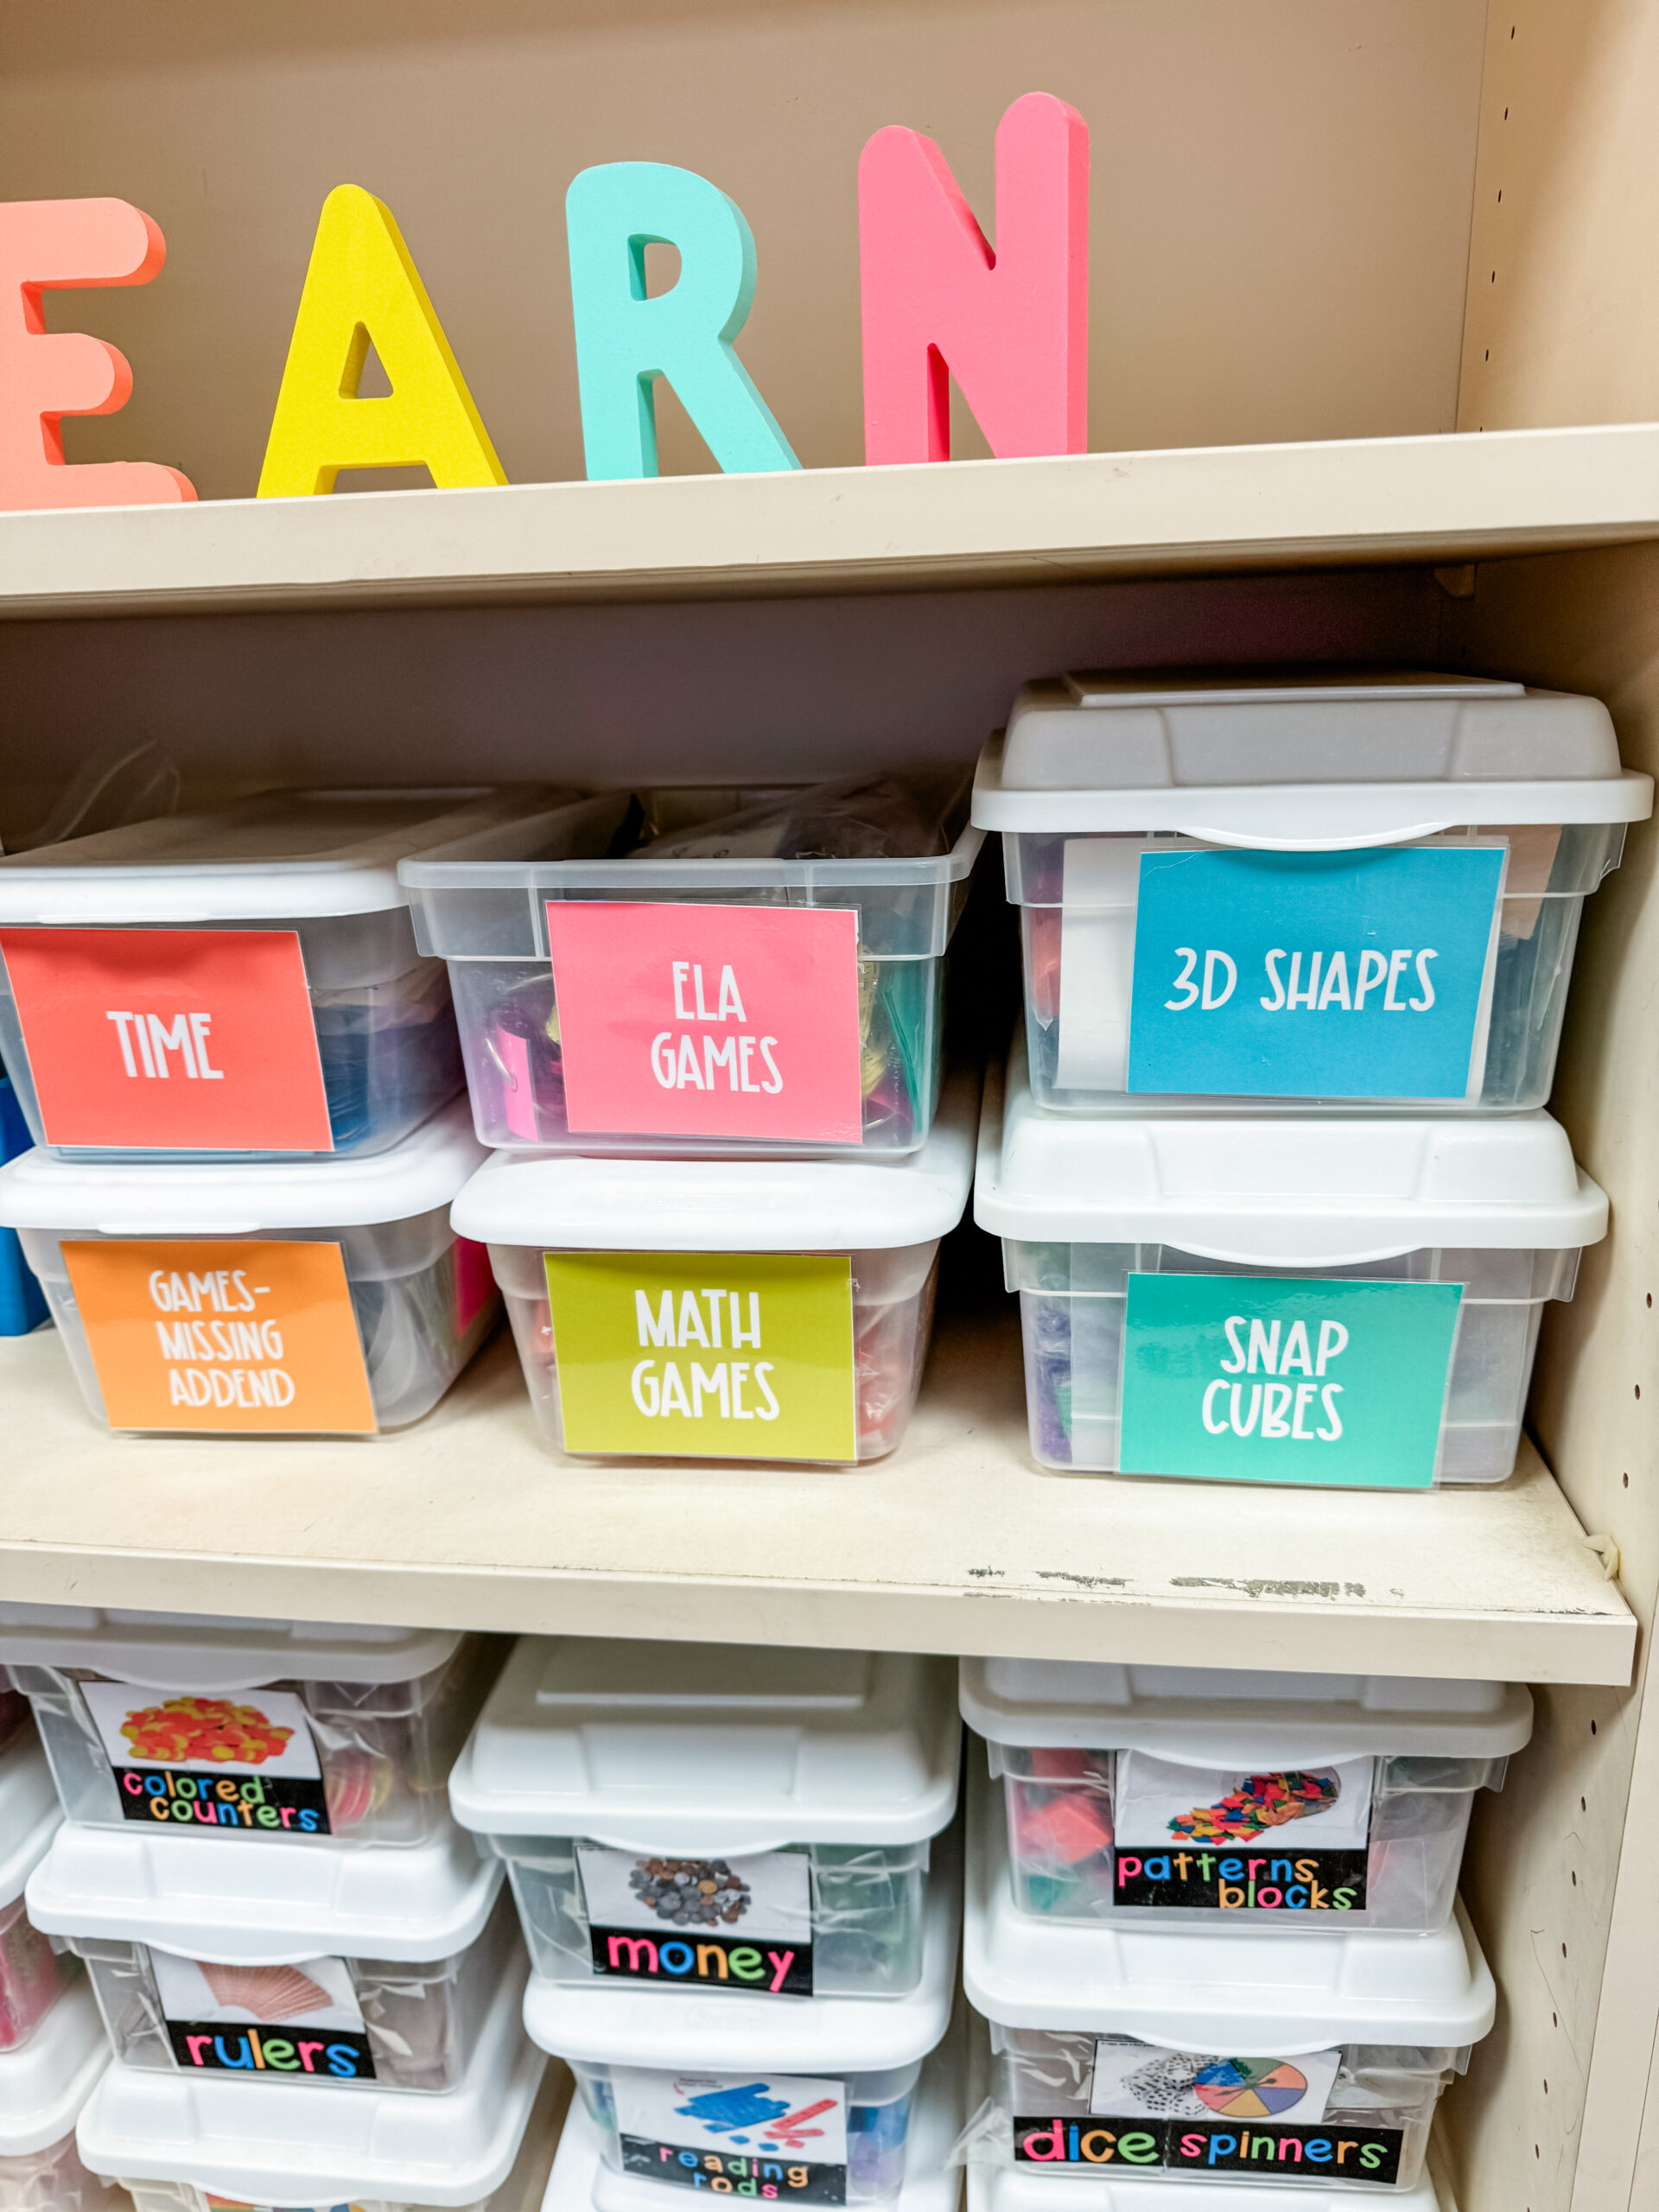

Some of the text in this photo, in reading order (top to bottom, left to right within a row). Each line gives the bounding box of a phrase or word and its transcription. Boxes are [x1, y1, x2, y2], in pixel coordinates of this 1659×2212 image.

[671, 961, 747, 1023] ELA
[1164, 947, 1440, 1013] 3D SHAPES
[105, 1010, 225, 1079] TIME
[650, 1032, 784, 1095] GAMES
[149, 1269, 271, 1313] GAMES-
[156, 1319, 284, 1362] MISSING
[634, 1288, 761, 1349] MATH
[1220, 1316, 1349, 1376] SNAP
[168, 1368, 296, 1408] ADDEND
[631, 1359, 780, 1421] GAMES
[1202, 1379, 1344, 1442] CUBES
[124, 1771, 264, 1805] colored
[149, 1795, 319, 1833] counters
[1118, 1852, 1319, 1887] patterns
[1218, 1878, 1357, 1910] blocks
[607, 1936, 795, 1993] money
[185, 2029, 359, 2079] rulers
[659, 2145, 808, 2188] reading
[1023, 2120, 1389, 2170] dice spinners
[693, 2174, 779, 2200] rods
